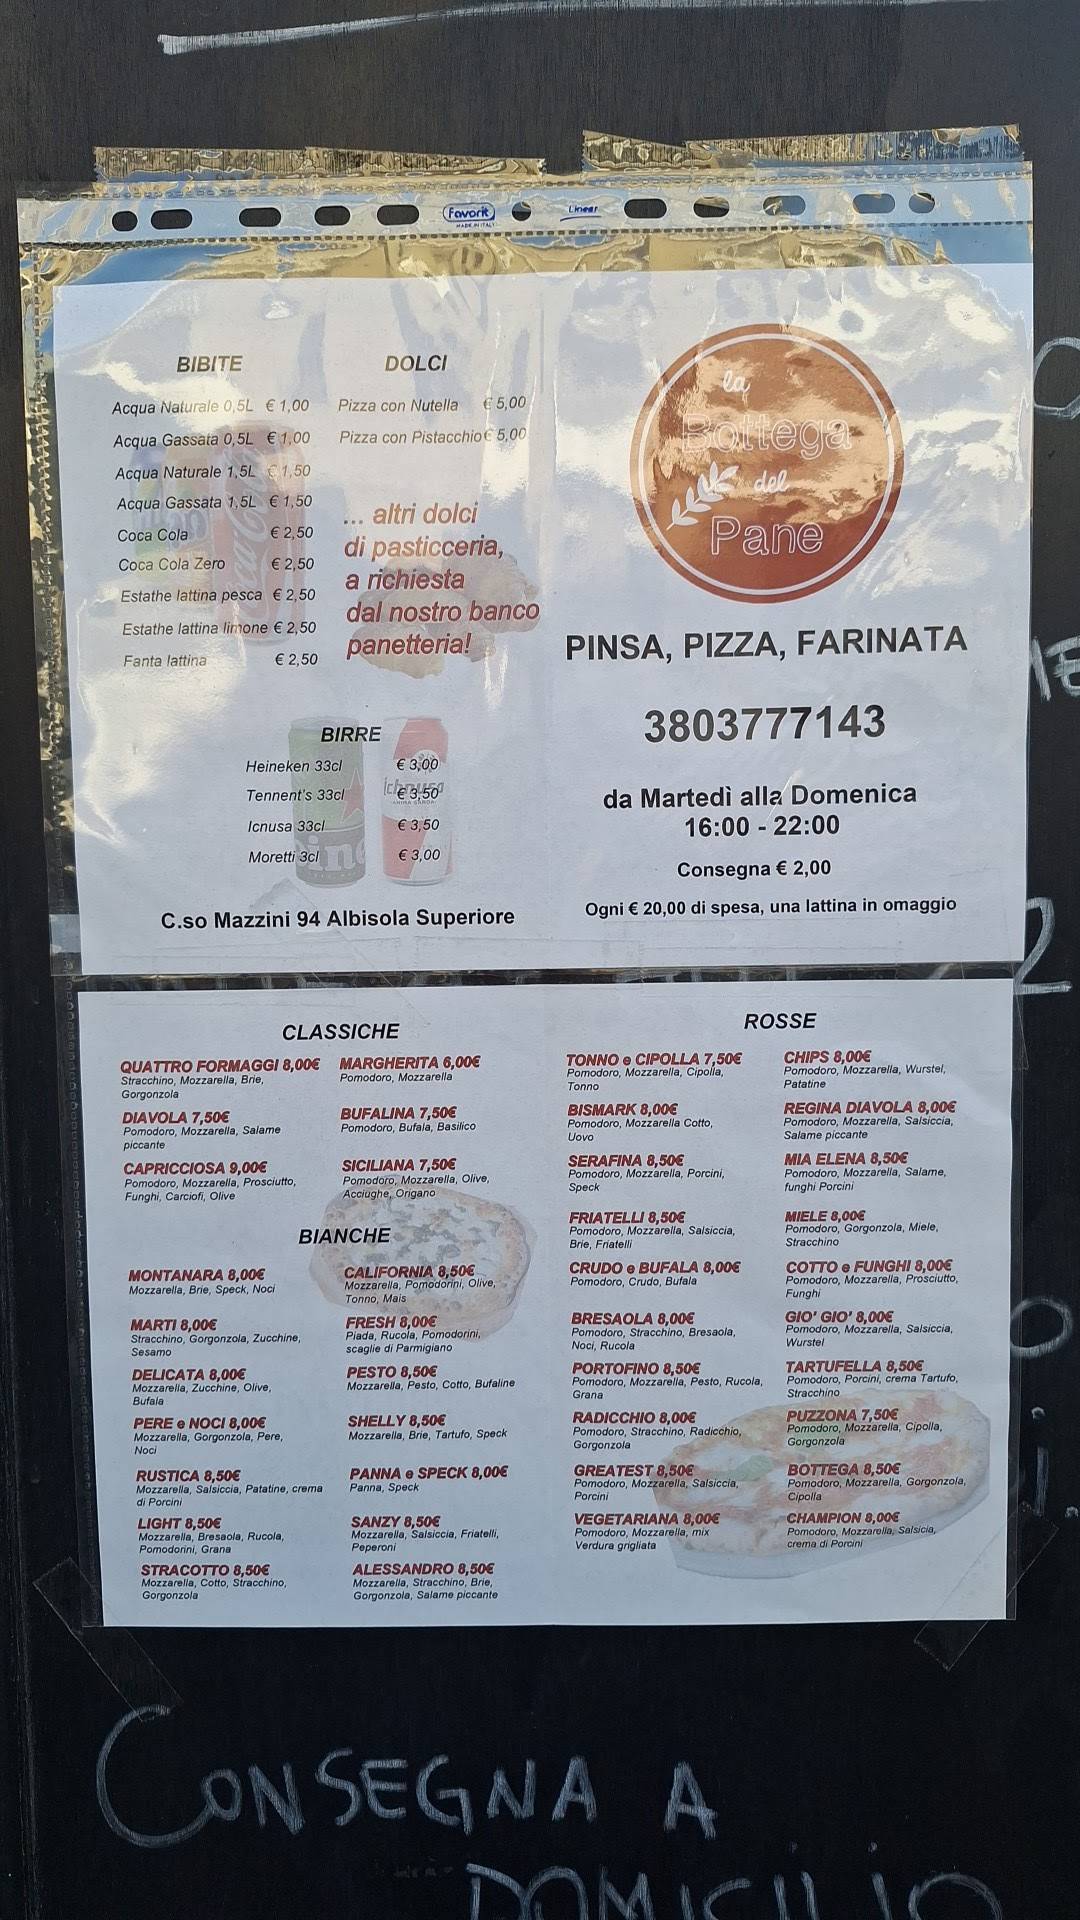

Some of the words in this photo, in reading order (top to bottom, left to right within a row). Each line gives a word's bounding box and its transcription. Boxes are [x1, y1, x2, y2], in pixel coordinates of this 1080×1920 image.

[448, 207, 489, 219] Favorit
[568, 204, 599, 213] Linear
[177, 355, 243, 373] BIBITE
[385, 354, 447, 371] DOLCI
[723, 371, 750, 395] la
[338, 399, 376, 412] Pizza
[381, 402, 406, 412] con
[411, 398, 458, 412] Nutella
[483, 396, 493, 410] €
[497, 396, 526, 411] 5,00
[113, 434, 157, 450] Acqua
[162, 433, 219, 447] Gassata
[224, 432, 254, 447] 0,5L
[267, 431, 277, 445] €
[281, 431, 310, 447] 1,00
[681, 413, 853, 459] Bottega
[753, 469, 790, 494] del
[117, 497, 160, 513] Acqua
[165, 496, 222, 510] Gassata
[228, 495, 256, 510] 1,5L
[269, 495, 279, 508] €
[282, 494, 312, 509] 1,50
[373, 502, 416, 525] altri
[423, 501, 478, 524] dolci
[117, 529, 152, 543] Coca
[157, 528, 188, 541] Cola
[270, 526, 280, 539] €
[283, 526, 314, 541] 2,50
[710, 516, 824, 556] Pane
[344, 536, 366, 557] di
[371, 537, 503, 561] pasticceria,
[118, 558, 153, 572] Coca
[158, 557, 189, 571] Cola
[194, 557, 225, 570] Zero
[271, 558, 281, 571] €
[284, 557, 314, 572] 2,50
[345, 573, 359, 590] a
[367, 567, 464, 591] richiesta
[121, 589, 172, 603] Estathe
[176, 589, 218, 603] lattina
[221, 590, 262, 604] pesca
[272, 588, 282, 601] €
[286, 588, 316, 603] 2,50
[346, 601, 383, 623] dal
[391, 601, 463, 623] nostro
[469, 600, 540, 622] banco
[346, 633, 473, 660] panetteria!
[567, 634, 672, 664] PINSA,
[685, 631, 785, 661] PIZZA,
[798, 626, 968, 655] FARINATA
[644, 704, 885, 743] 3803777143
[321, 726, 382, 742] BIRRE
[246, 760, 310, 773] Heineken
[314, 759, 342, 772] 33cl
[396, 758, 406, 771] €
[409, 758, 439, 773] 3,00
[603, 789, 632, 809] da
[641, 786, 731, 808] Martedì
[740, 786, 782, 806] alla
[792, 783, 916, 805] Domenica
[248, 820, 292, 833] Icnusa
[297, 820, 325, 832] 33cl
[398, 819, 407, 831] €
[409, 818, 440, 832] 3,50
[685, 816, 749, 837] 16:00
[774, 814, 839, 835] 22:00
[249, 851, 296, 863] Moretti
[299, 850, 320, 863] 3cl
[398, 849, 408, 861] €
[411, 849, 440, 863] 3,00
[677, 862, 771, 880] Consegna
[776, 860, 787, 876] €
[793, 860, 831, 878] 2,00
[585, 902, 623, 919] Ogni
[628, 902, 638, 916] €
[643, 901, 686, 917] 20,00
[691, 900, 705, 914] di
[711, 903, 764, 917] spesa,
[770, 902, 800, 913] una
[806, 898, 857, 912] lattina
[863, 898, 877, 911] in
[883, 897, 956, 914] omaggio
[161, 912, 207, 929] C.so
[214, 911, 290, 928] Mazzini
[297, 911, 321, 927] 94
[327, 909, 409, 927] Albisola
[416, 908, 515, 929] Superiore
[744, 1013, 817, 1029] ROSSE
[283, 1023, 400, 1041] CLASSICHE
[339, 1056, 439, 1070] MARGHERITA
[443, 1055, 481, 1070] 6,00€
[566, 1053, 619, 1067] TONNO
[622, 1056, 632, 1066] e
[635, 1053, 700, 1066] CIPOLLA
[704, 1052, 743, 1067] 7,50€
[784, 1050, 830, 1064] CHIPS
[833, 1050, 872, 1064] 8,00€
[120, 1060, 193, 1074] QUATTRO
[196, 1059, 279, 1073] FORMAGGI
[282, 1058, 320, 1073] 8,00€
[567, 1068, 621, 1078] Pomodoro,
[625, 1067, 682, 1078] Mozzarella,
[687, 1067, 723, 1078] Cipolla,
[784, 1066, 839, 1076] Pomodoro,
[843, 1065, 901, 1075] Mozzarella,
[906, 1064, 946, 1074] Wurstel,
[121, 1076, 176, 1086] Stracchino,
[180, 1075, 237, 1085] Mozzarella,
[241, 1074, 264, 1085] Brie,
[340, 1073, 394, 1083] Pomodoro,
[398, 1072, 452, 1082] Mozzarella
[784, 1080, 826, 1089] Patatine
[568, 1082, 599, 1091] Tonno
[121, 1089, 179, 1101] Gorgonzola
[299, 1228, 391, 1244] BIANCHE
[128, 1269, 224, 1282] MONTANARA
[228, 1268, 266, 1282] 8,00€
[129, 1285, 185, 1296] Mozzarella,
[189, 1285, 211, 1295] Brie,
[215, 1285, 249, 1296] Speck,
[252, 1284, 275, 1294] Noci
[571, 1312, 653, 1325] BRESAOLA
[657, 1312, 695, 1326] 8,00€
[347, 1366, 397, 1379] PESTO
[400, 1365, 438, 1380] 8,50€
[786, 1360, 882, 1373] TARTUFELLA
[886, 1360, 924, 1373] 8,50€
[347, 1381, 403, 1391] Mozzarella,
[407, 1381, 438, 1391] Pesto,
[442, 1380, 471, 1390] Cotto,
[475, 1379, 515, 1388] Bufaline
[574, 1513, 679, 1525] VEGETARIANA
[682, 1512, 721, 1527] 8,00€
[787, 1512, 862, 1524] CHAMPION
[864, 1511, 900, 1525] 8,00€
[576, 1541, 615, 1550] Verdura
[617, 1541, 656, 1552] grigliata
[141, 1564, 230, 1576] STRACOTTO
[233, 1564, 270, 1577] 8,50€
[353, 1563, 454, 1576] ALESSANDRO
[458, 1563, 495, 1577] 8,50€
[141, 1579, 197, 1589] Mozzarella,
[200, 1578, 230, 1588] Cotto,
[233, 1578, 286, 1588] Stracchino,
[353, 1591, 413, 1602] Gorgonzola,
[417, 1590, 454, 1599] Salame
[457, 1590, 498, 1601] piccante
[663, 1761, 719, 1841] A
